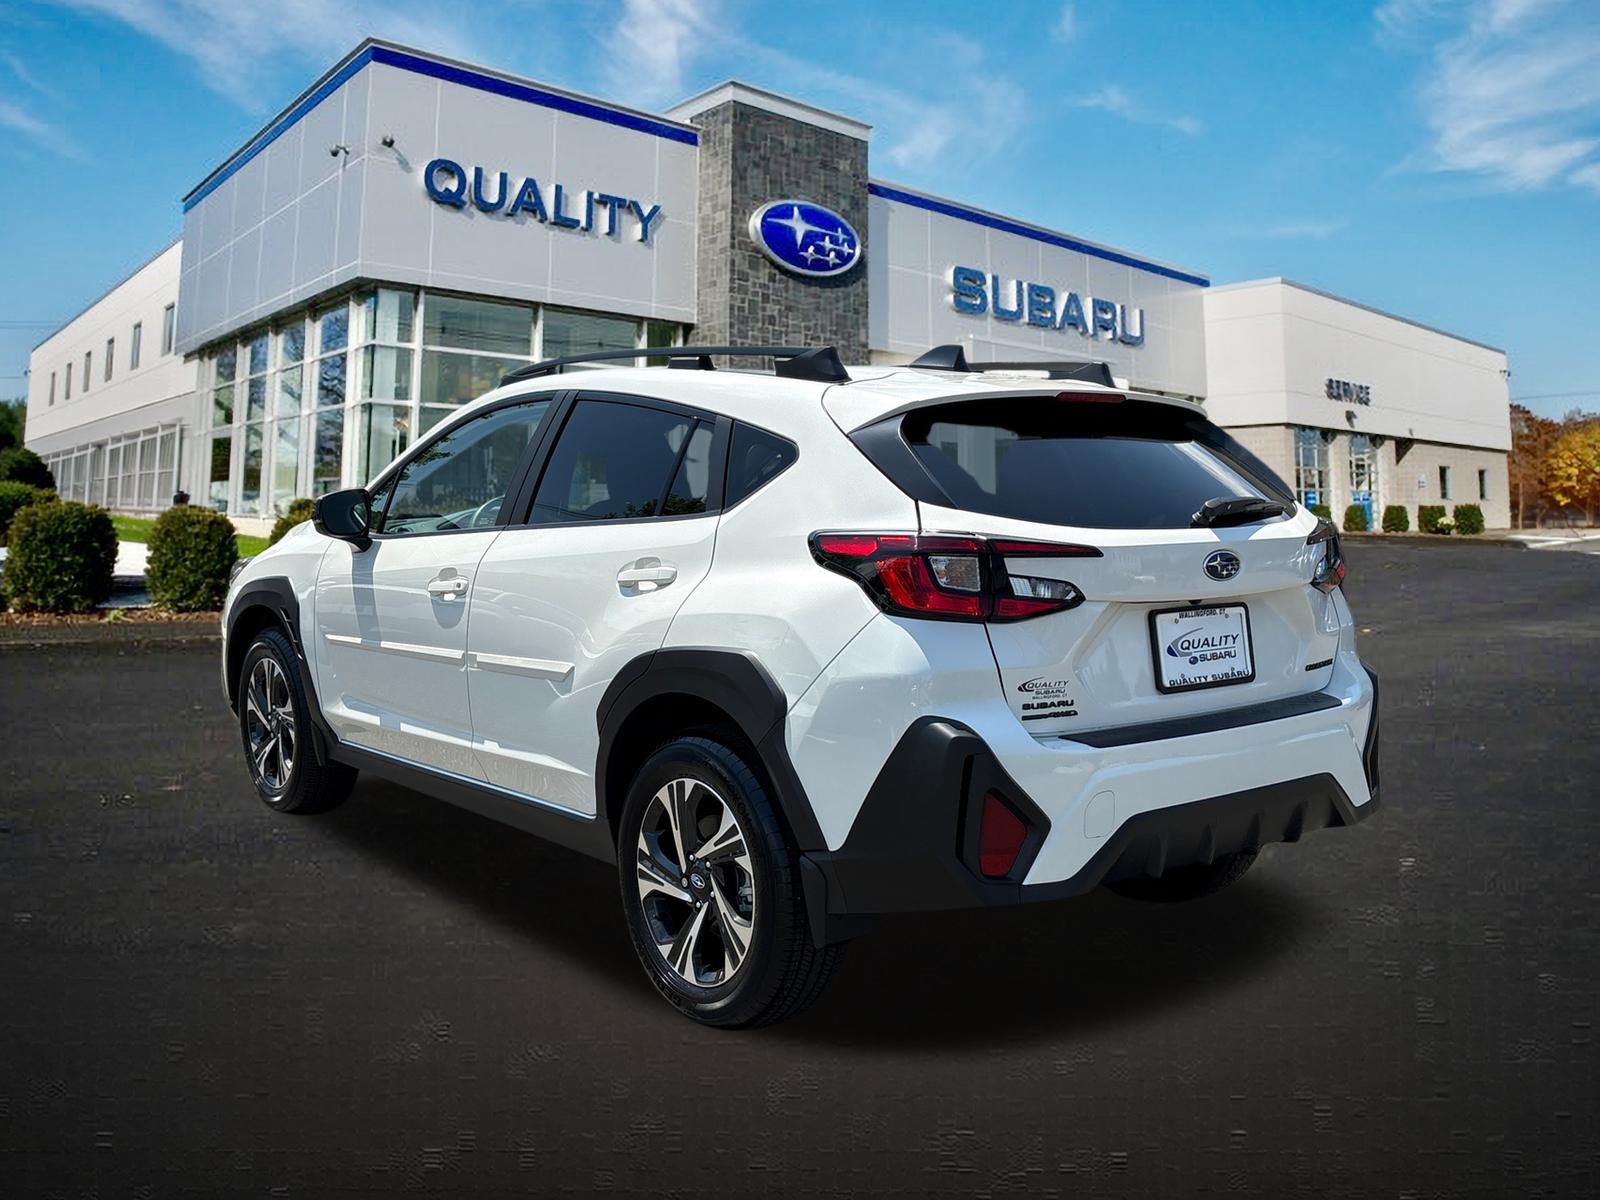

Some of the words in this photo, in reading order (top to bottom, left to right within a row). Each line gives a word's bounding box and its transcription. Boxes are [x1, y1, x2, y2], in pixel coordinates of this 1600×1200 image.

[423, 157, 662, 243] QUALITY
[952, 265, 1145, 347] SUBARU
[1325, 377, 1371, 407] SERVICE
[1180, 633, 1239, 651] QUALITY
[1198, 650, 1237, 662] SUBARU
[1169, 673, 1208, 687] QUALITY
[1211, 669, 1250, 681] SUBARU
[1027, 680, 1070, 689] QUALITY
[1022, 700, 1074, 710] SUBARU
